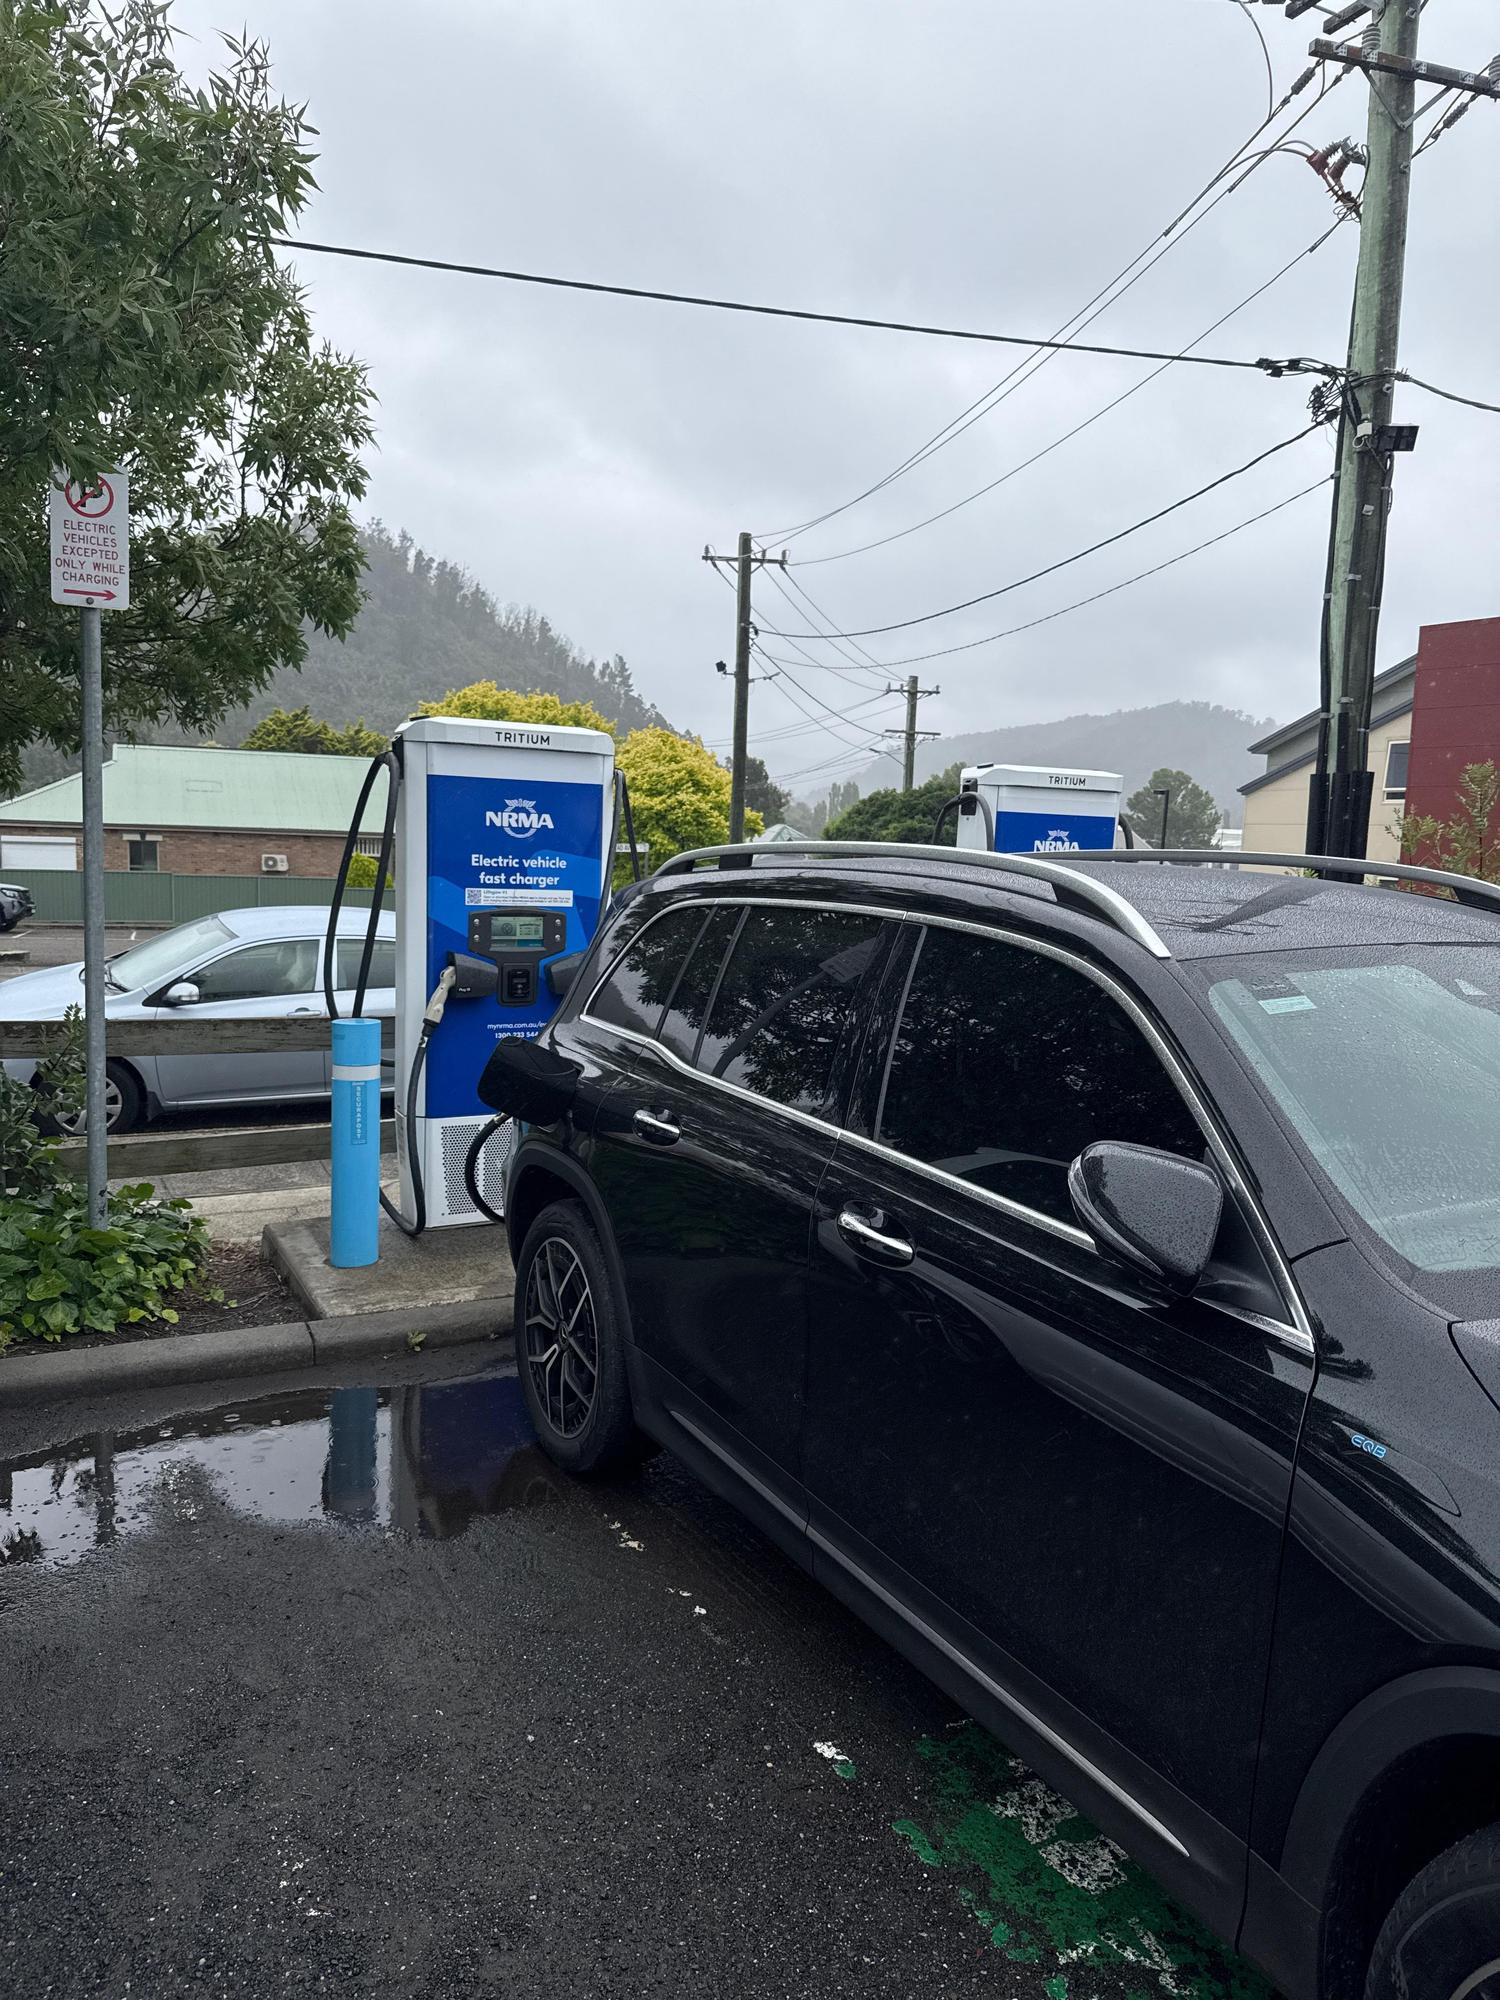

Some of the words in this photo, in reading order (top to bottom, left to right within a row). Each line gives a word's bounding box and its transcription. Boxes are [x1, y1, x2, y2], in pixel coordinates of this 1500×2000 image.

[63, 520, 116, 535] ELECTRIC
[63, 532, 117, 548] VEHICLES
[62, 545, 119, 560] EXCEPTED
[55, 558, 86, 570] ONLY
[93, 562, 126, 574] WHILE
[62, 571, 119, 586] CHARGING
[495, 731, 550, 746] TRITIUM
[1048, 776, 1086, 786] TRITIUM
[485, 811, 554, 829] NRMA
[1034, 840, 1079, 852] NRMA
[471, 854, 519, 868] Electric
[522, 856, 567, 869] vehicle
[479, 872, 506, 884] fast
[509, 873, 560, 888] charger
[1351, 1435, 1387, 1458] EQB
